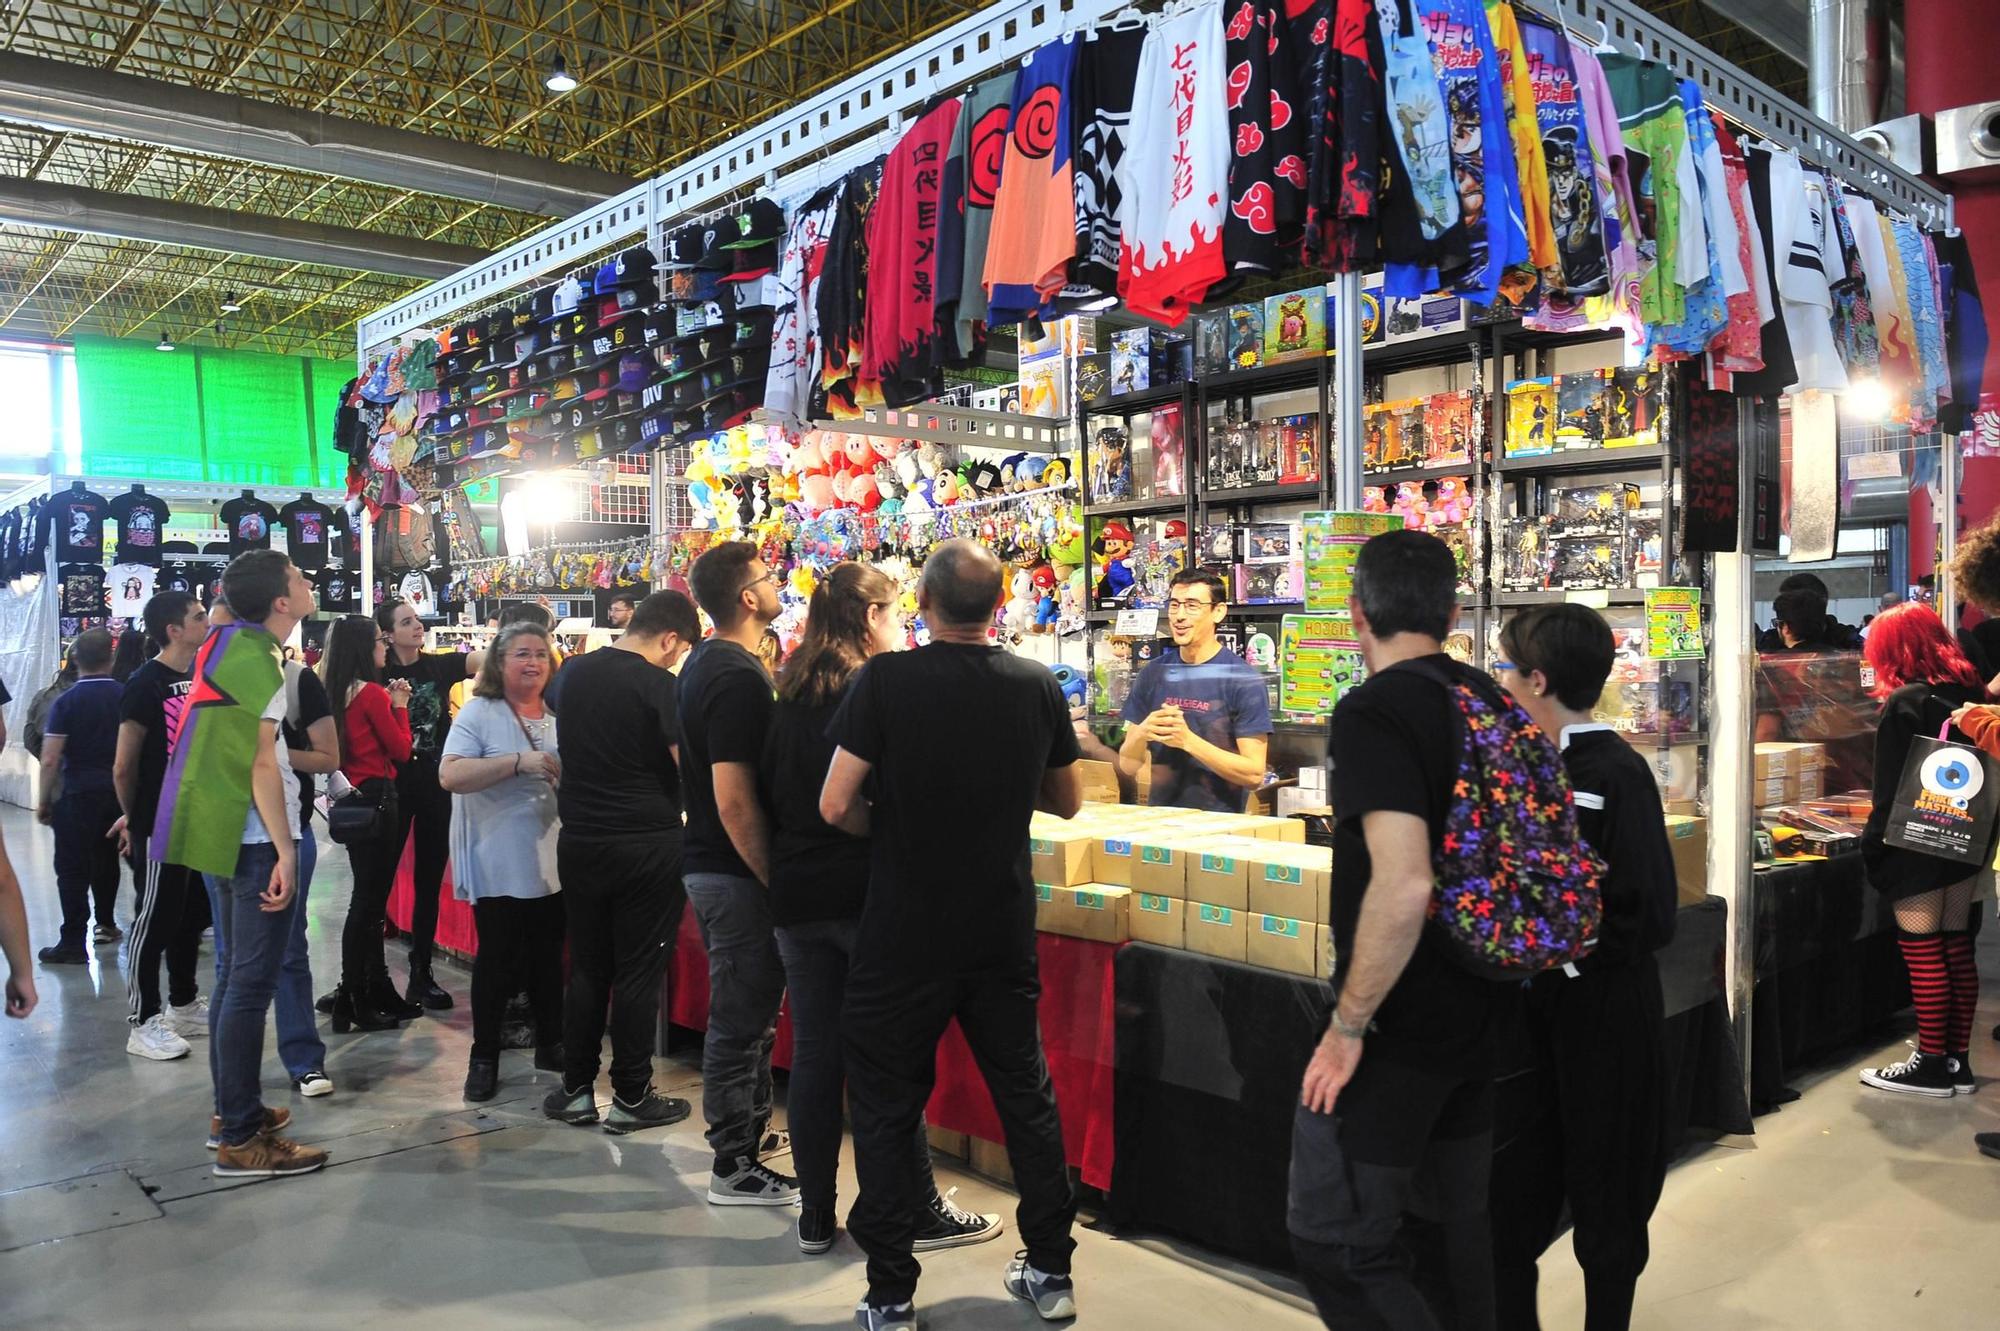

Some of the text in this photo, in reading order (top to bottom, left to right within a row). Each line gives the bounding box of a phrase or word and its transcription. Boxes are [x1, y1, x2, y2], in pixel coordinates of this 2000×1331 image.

[1168, 41, 1198, 211] 七代目火影
